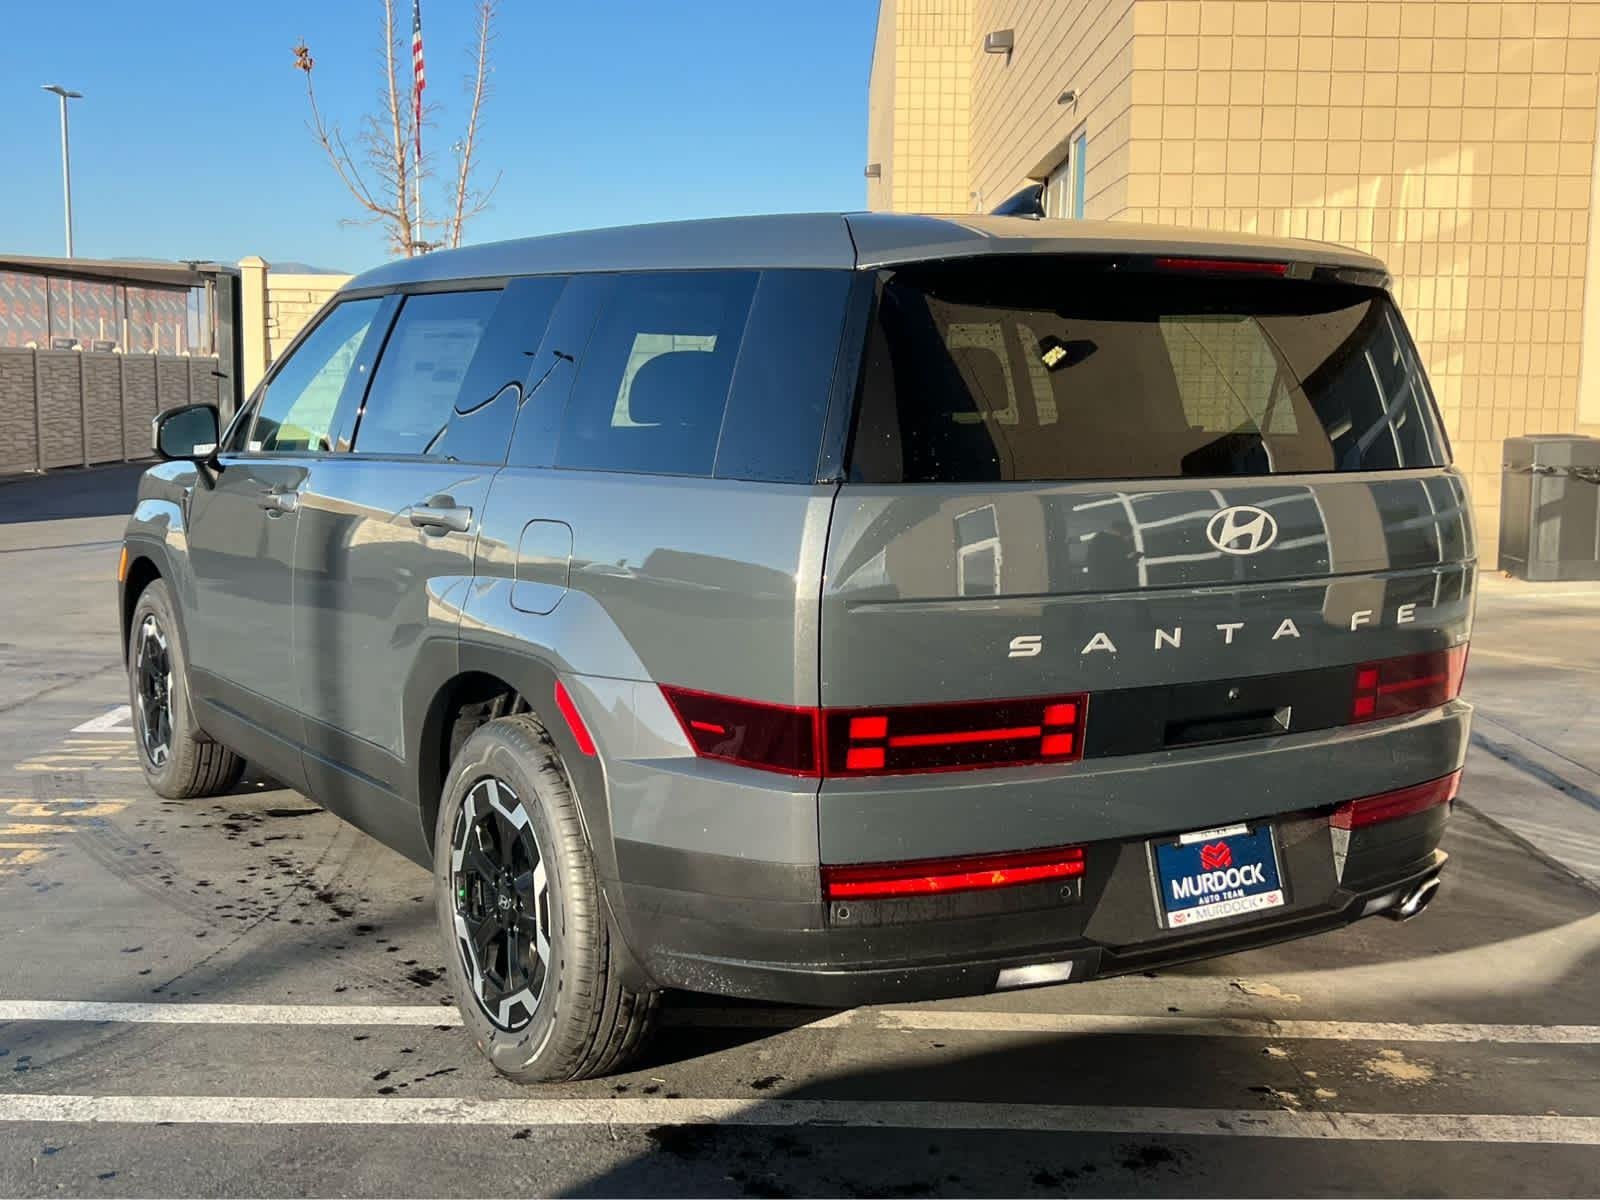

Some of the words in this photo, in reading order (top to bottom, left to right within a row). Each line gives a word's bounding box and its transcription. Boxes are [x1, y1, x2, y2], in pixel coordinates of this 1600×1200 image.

[1008, 618, 1301, 658] SANTA
[1350, 603, 1417, 631] FE
[1171, 862, 1266, 899] MURDOCK
[1195, 897, 1258, 919] MURDOCK
[1198, 893, 1220, 905] AUTO
[1222, 888, 1245, 900] TEAM
